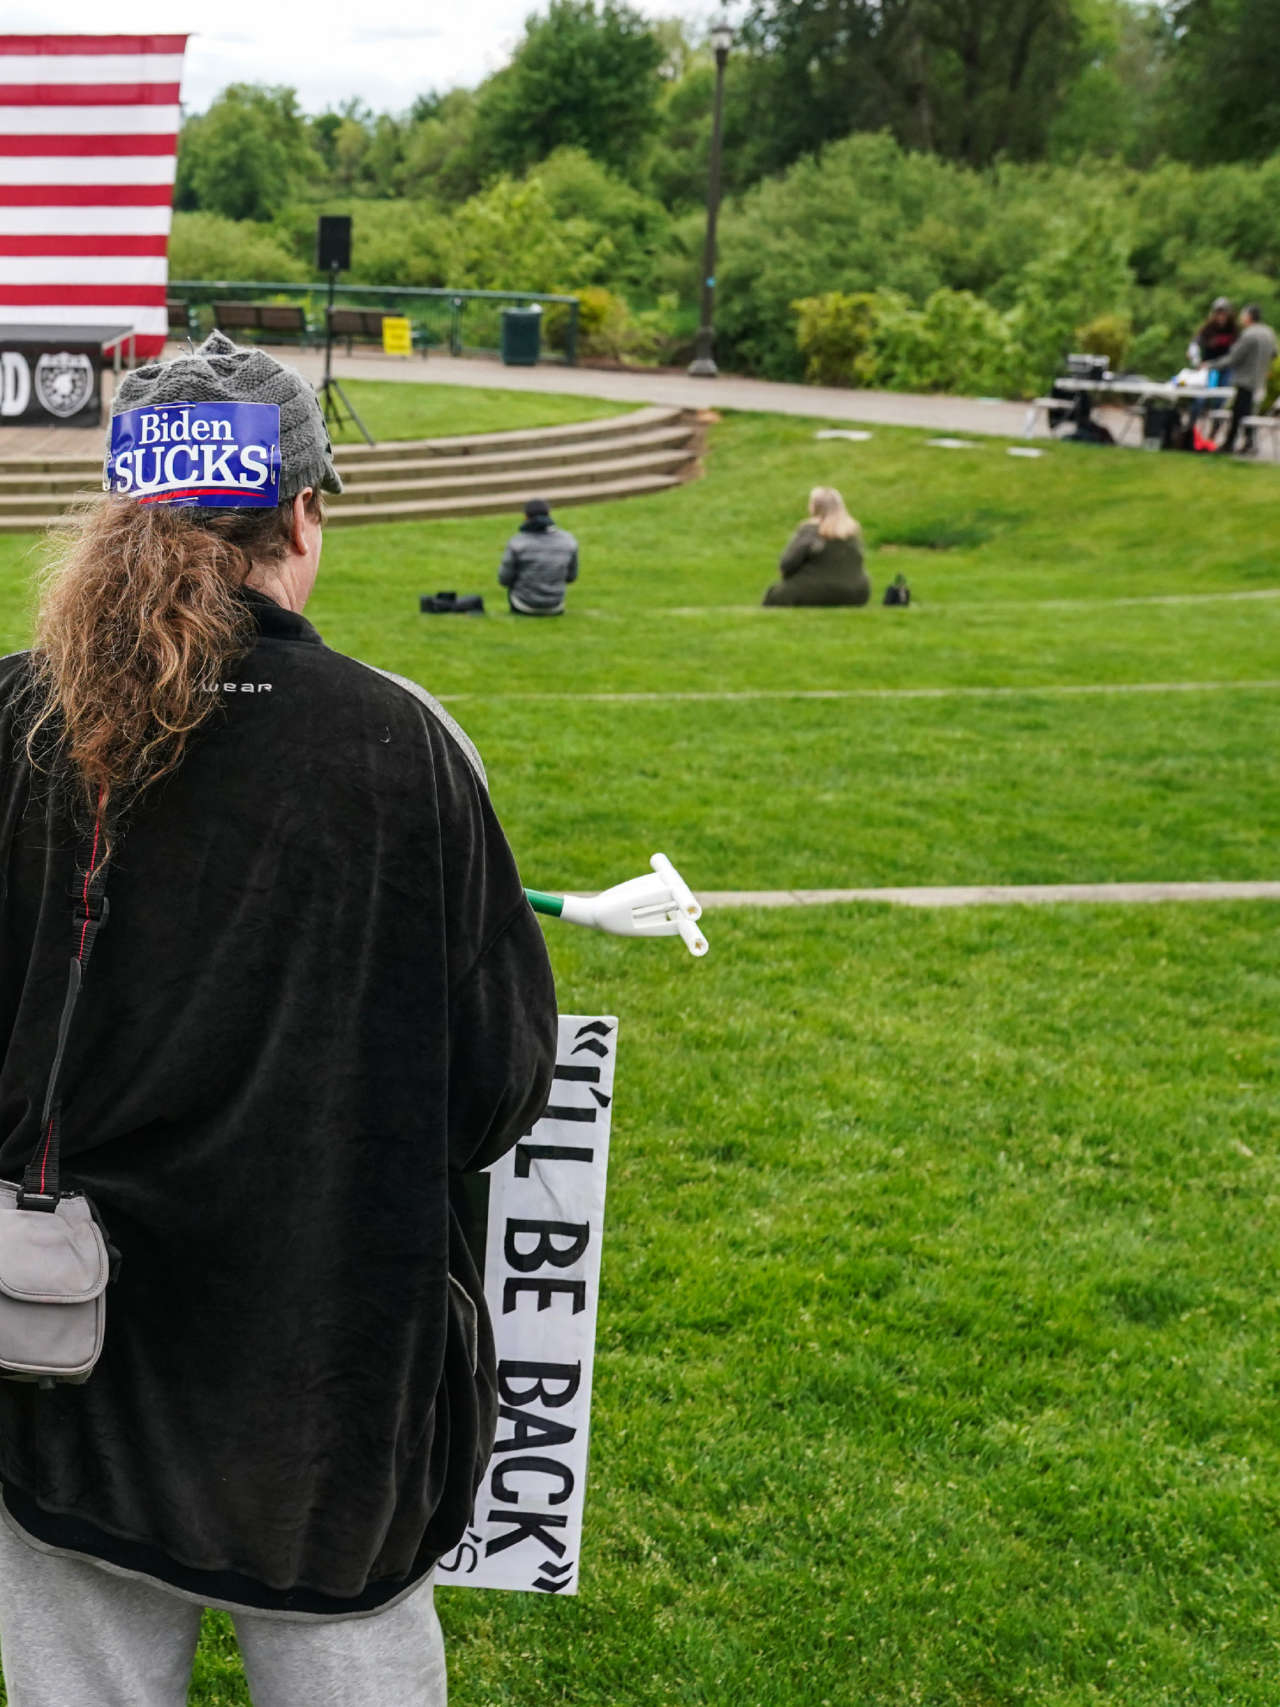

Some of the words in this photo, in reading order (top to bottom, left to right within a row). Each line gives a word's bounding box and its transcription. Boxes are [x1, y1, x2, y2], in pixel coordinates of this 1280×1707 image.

[139, 410, 233, 444] Biden
[115, 444, 269, 493] SUCKS
[503, 1217, 590, 1316] BE
